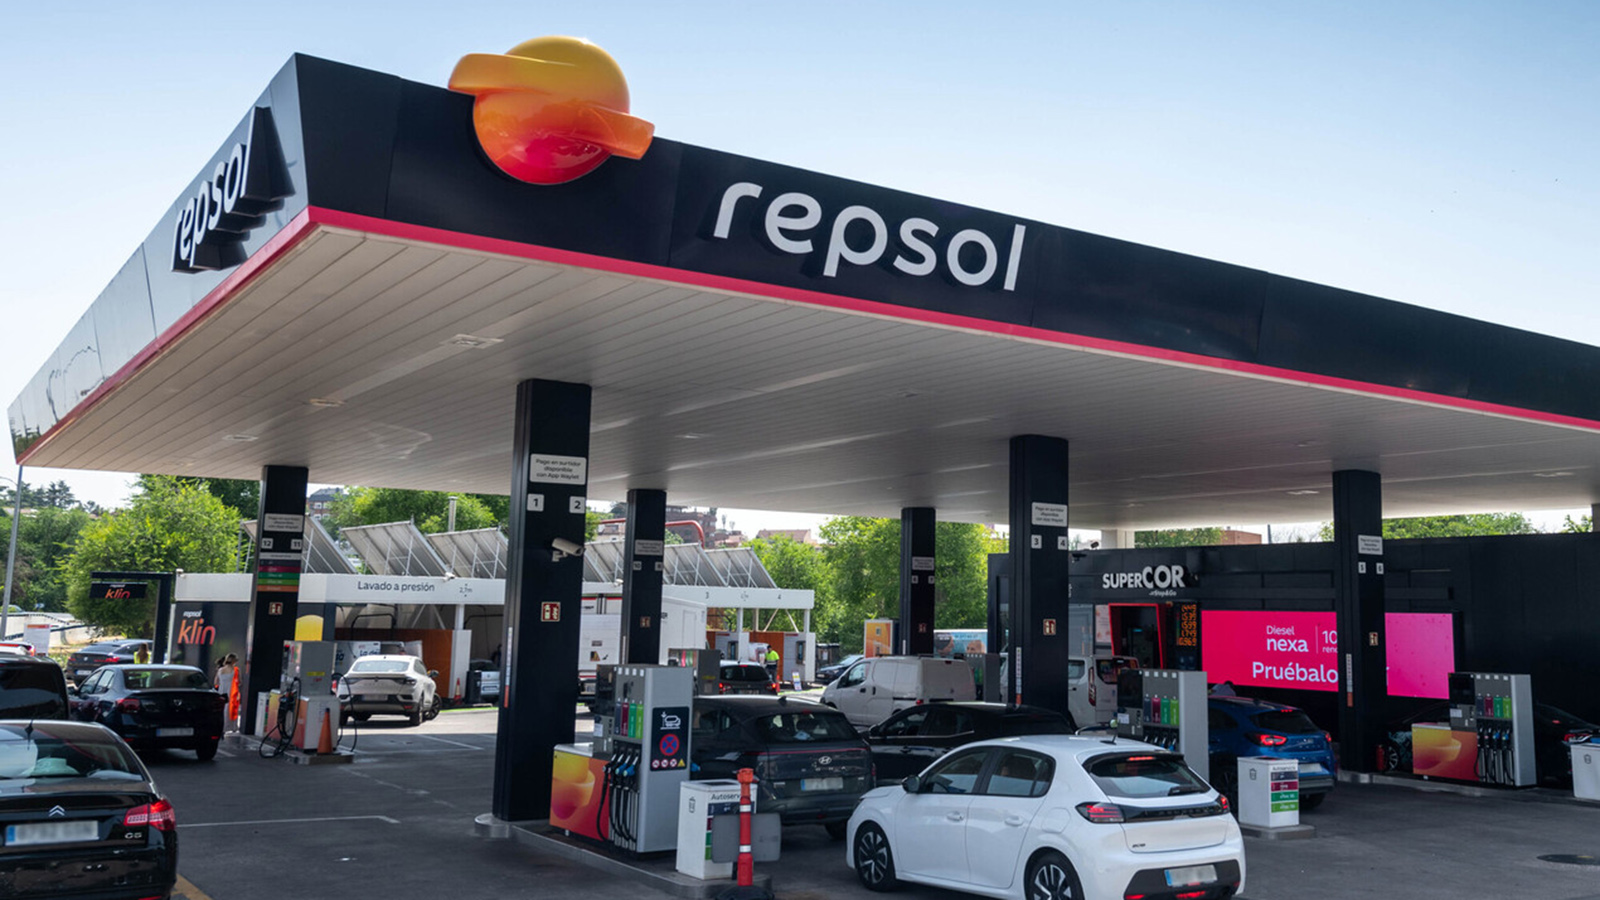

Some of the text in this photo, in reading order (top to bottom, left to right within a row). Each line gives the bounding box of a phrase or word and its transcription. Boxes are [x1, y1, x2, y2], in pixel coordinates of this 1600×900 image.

[171, 106, 257, 272] repsol
[713, 182, 1026, 291] repsol
[534, 498, 538, 507] 1
[574, 500, 581, 509] 2
[1034, 538, 1039, 546] 3
[1102, 564, 1186, 589] SUPERCOR
[358, 581, 392, 591] Lavado
[402, 582, 434, 592] presión
[105, 588, 130, 599] klin
[178, 618, 216, 646] klin
[1266, 625, 1294, 636] Diesel
[1267, 638, 1308, 652] nexa
[1252, 661, 1338, 684] Pruébalo
